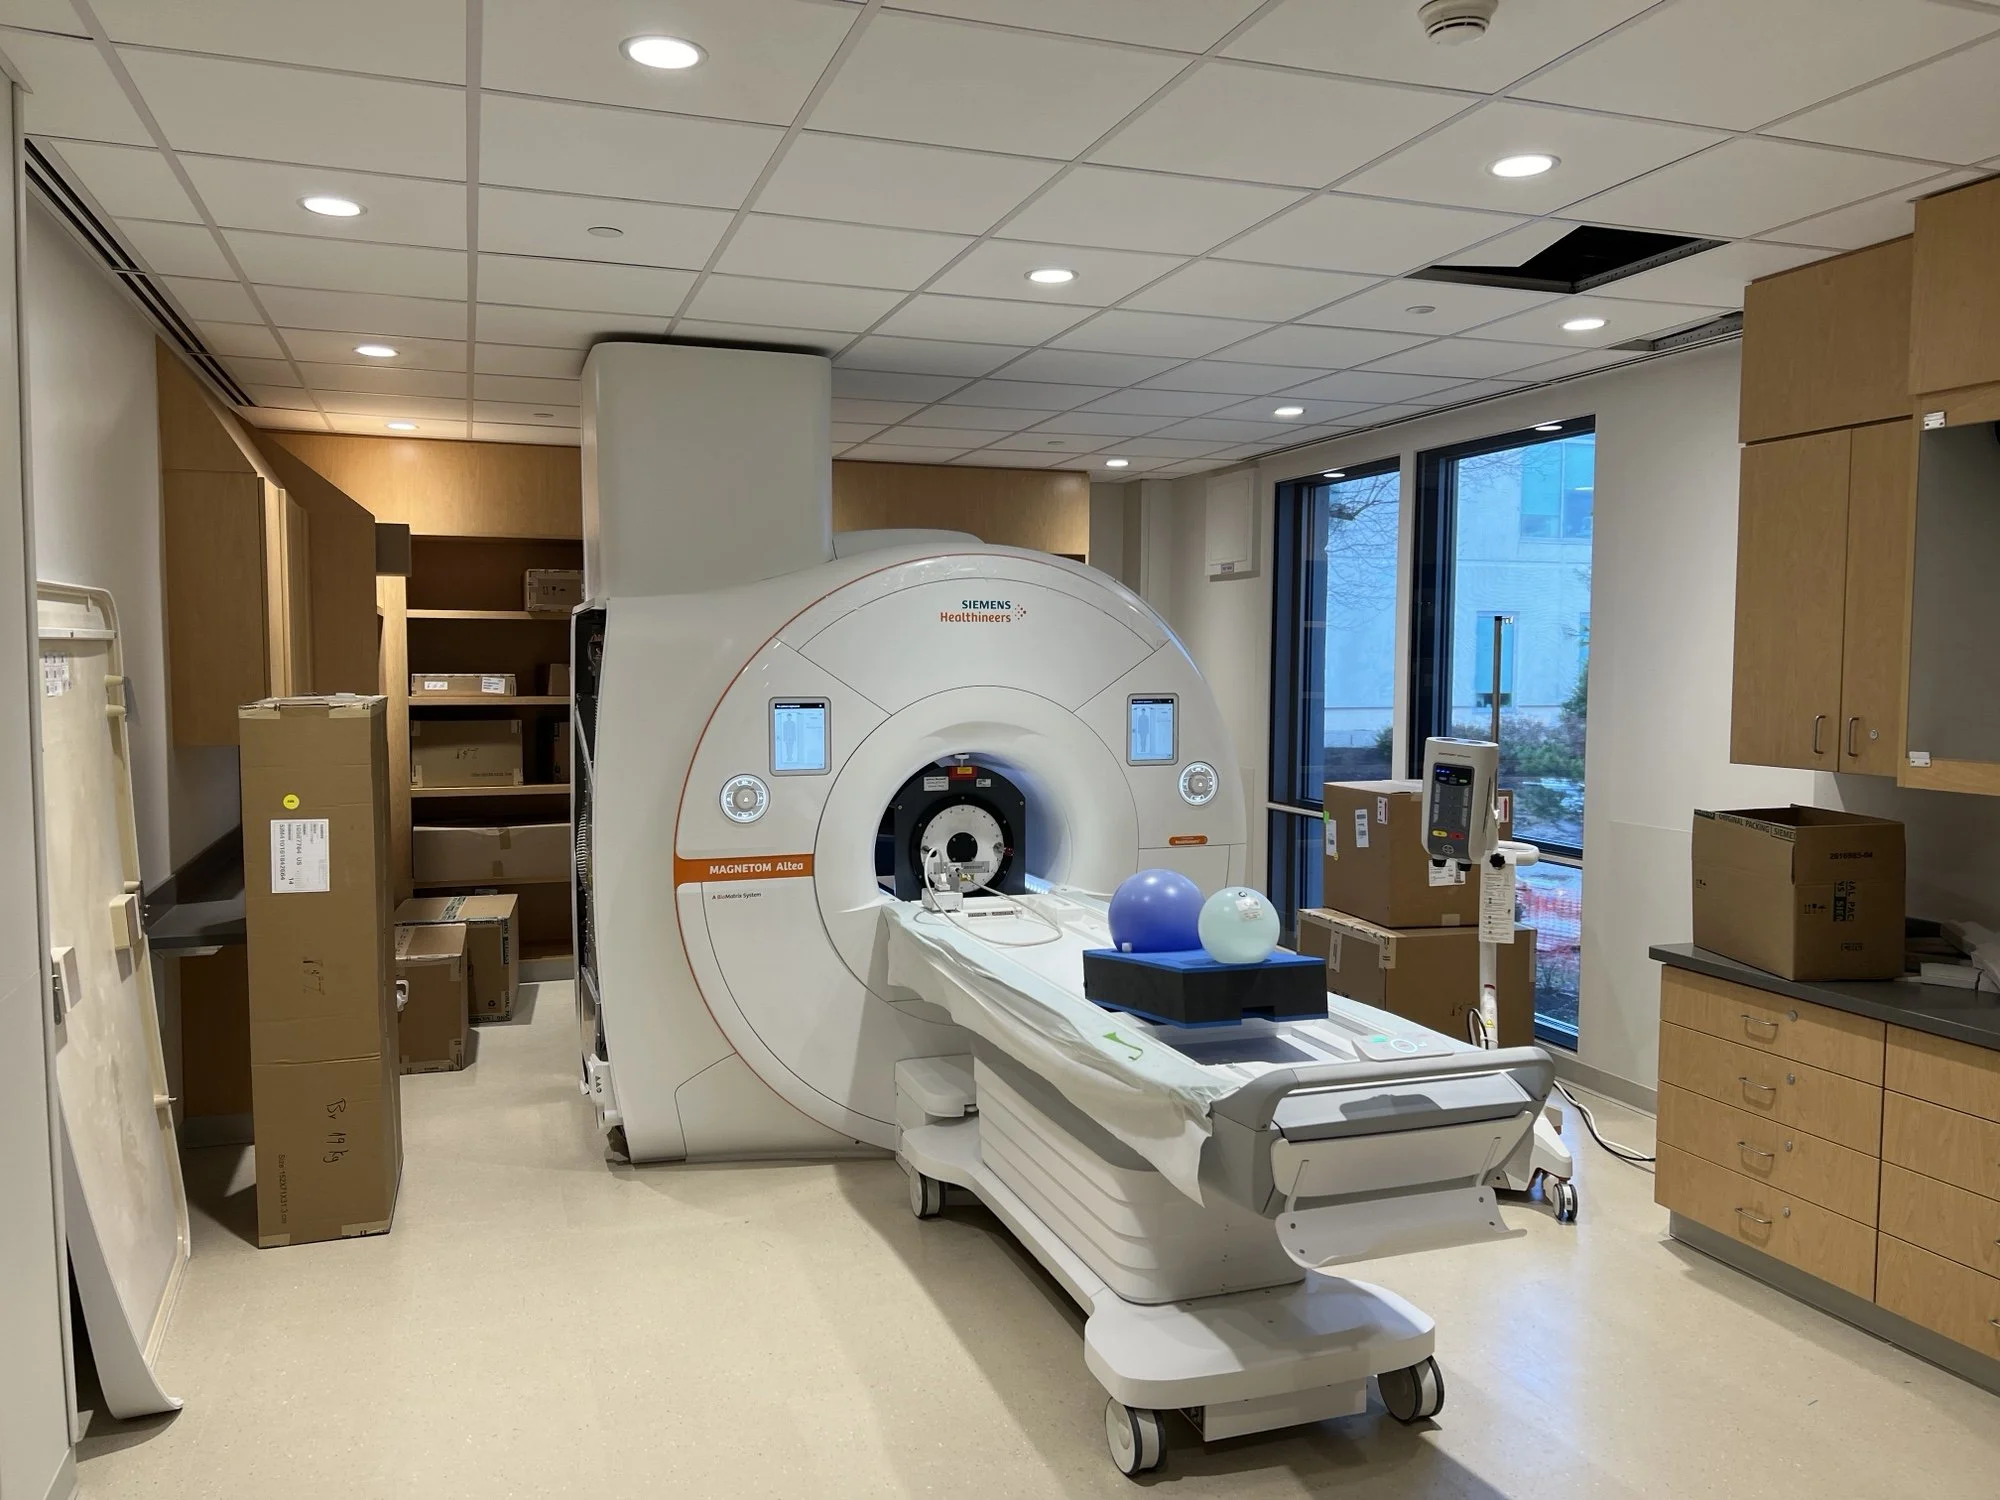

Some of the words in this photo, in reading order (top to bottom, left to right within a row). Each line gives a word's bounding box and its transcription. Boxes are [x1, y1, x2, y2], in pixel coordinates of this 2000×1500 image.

[962, 600, 1011, 609] SIEMENS
[940, 612, 1011, 622] Healthineers
[1718, 814, 1744, 826] ORIGINAL
[1745, 820, 1770, 833] PACKING
[709, 862, 772, 875] MAGNETOM
[776, 861, 804, 871] Altea
